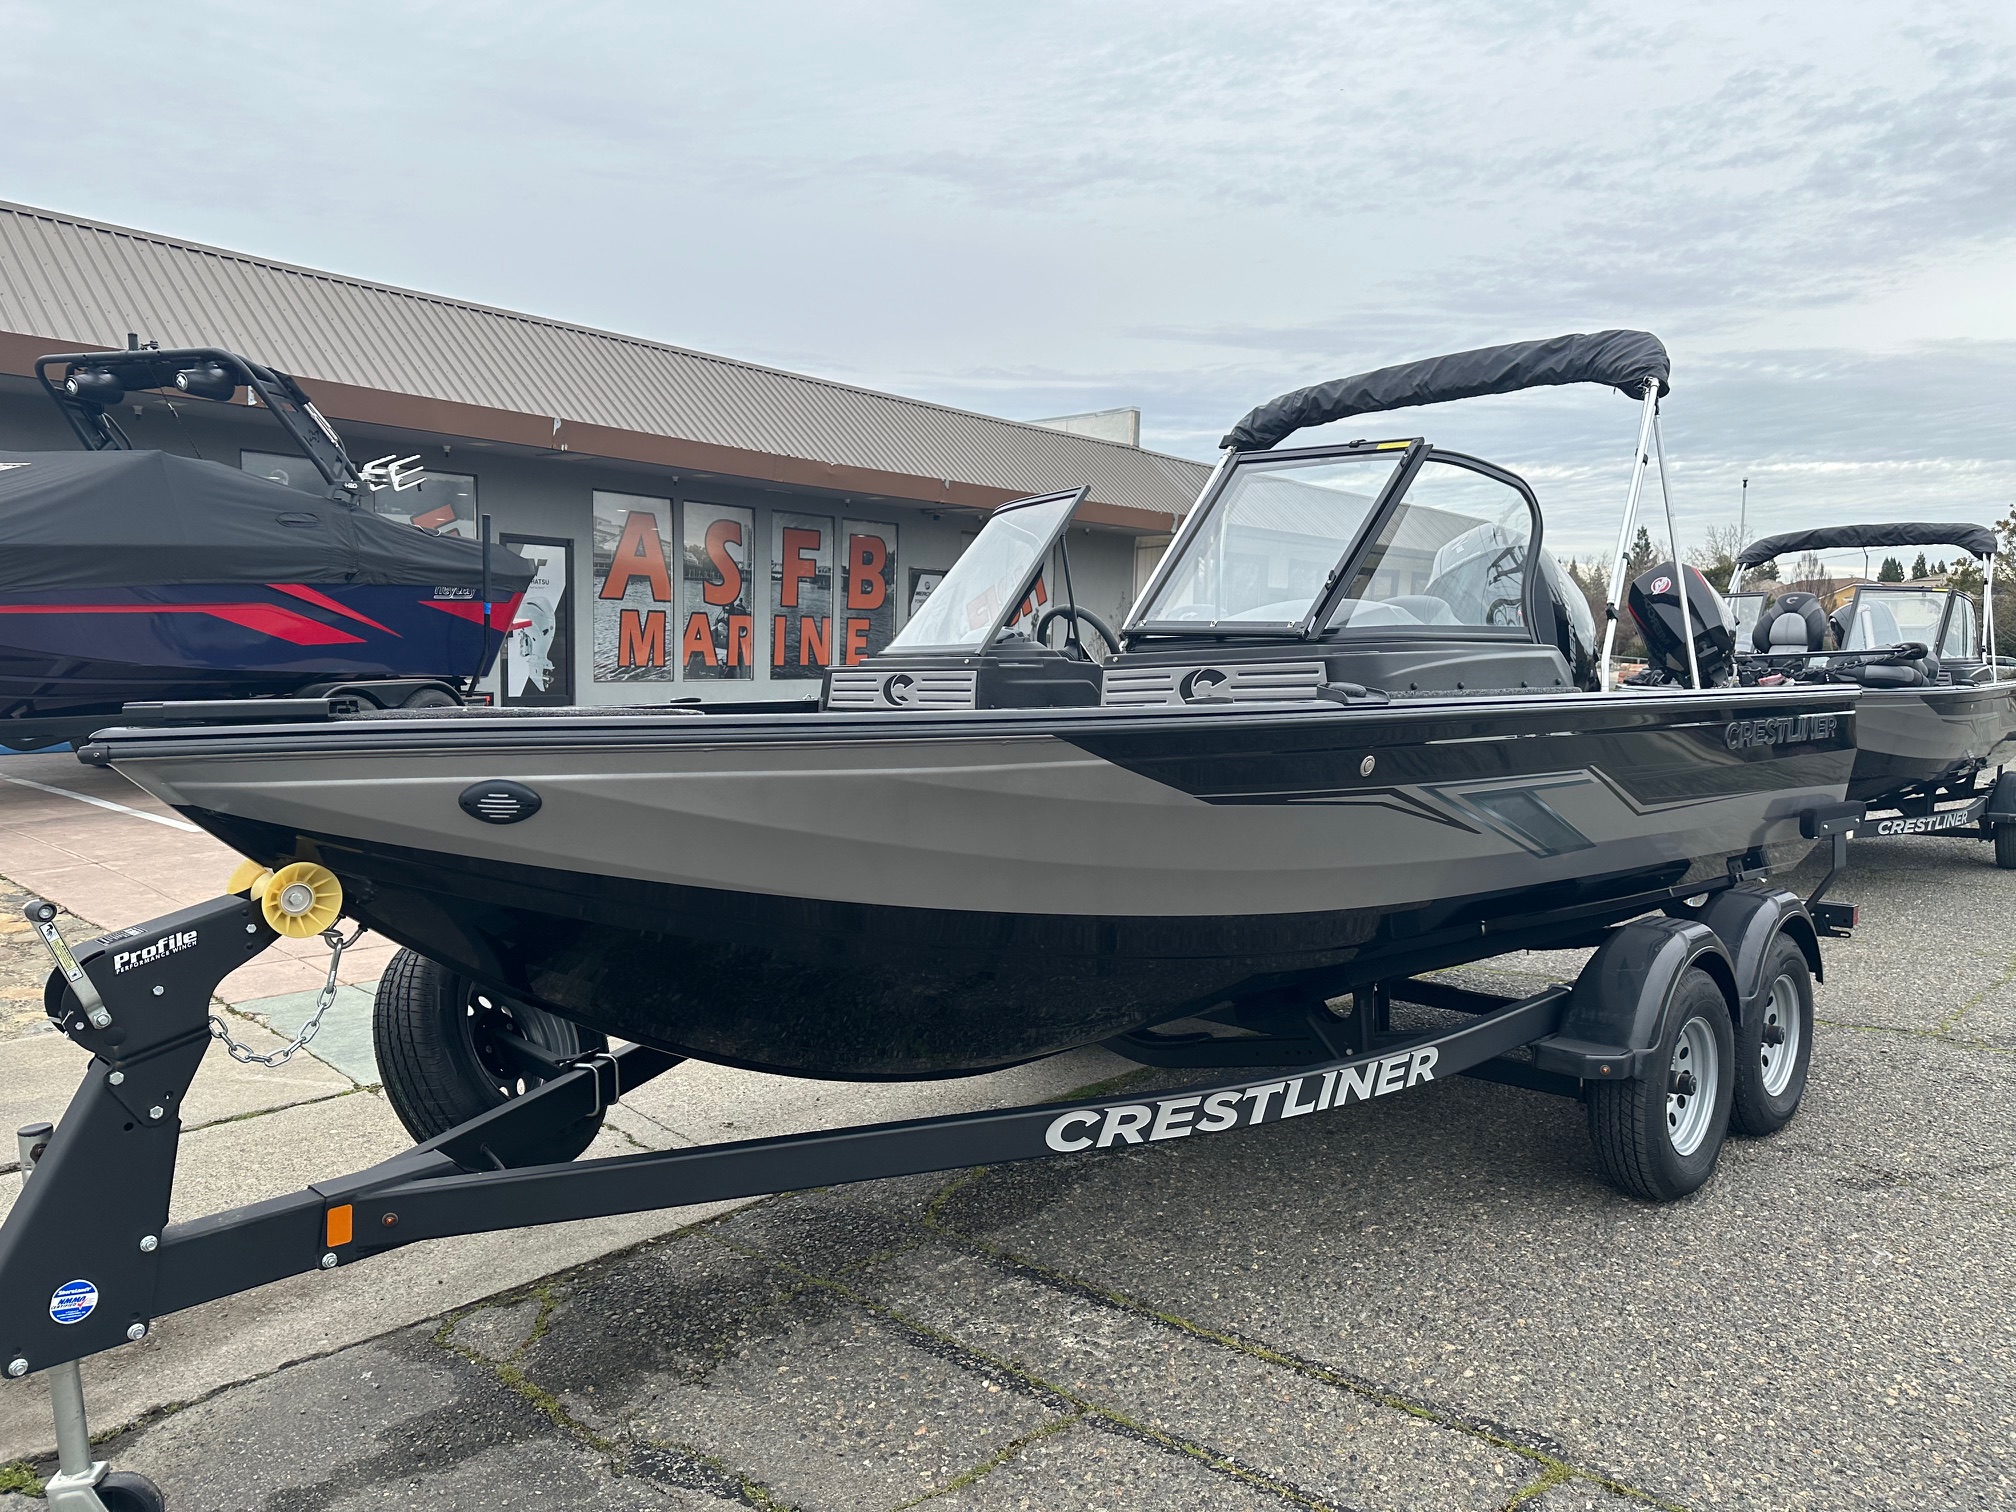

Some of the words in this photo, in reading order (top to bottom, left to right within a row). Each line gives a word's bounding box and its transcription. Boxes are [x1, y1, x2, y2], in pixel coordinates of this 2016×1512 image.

[617, 608, 871, 668] MARINE
[1724, 715, 1838, 750] CRESTLINER
[1877, 809, 1969, 836] CRESTLINER
[113, 930, 198, 971] Profile
[116, 950, 170, 975] PERFORMANCE
[172, 940, 198, 954] WINCH
[1044, 1046, 1440, 1153] CRESTLINER
